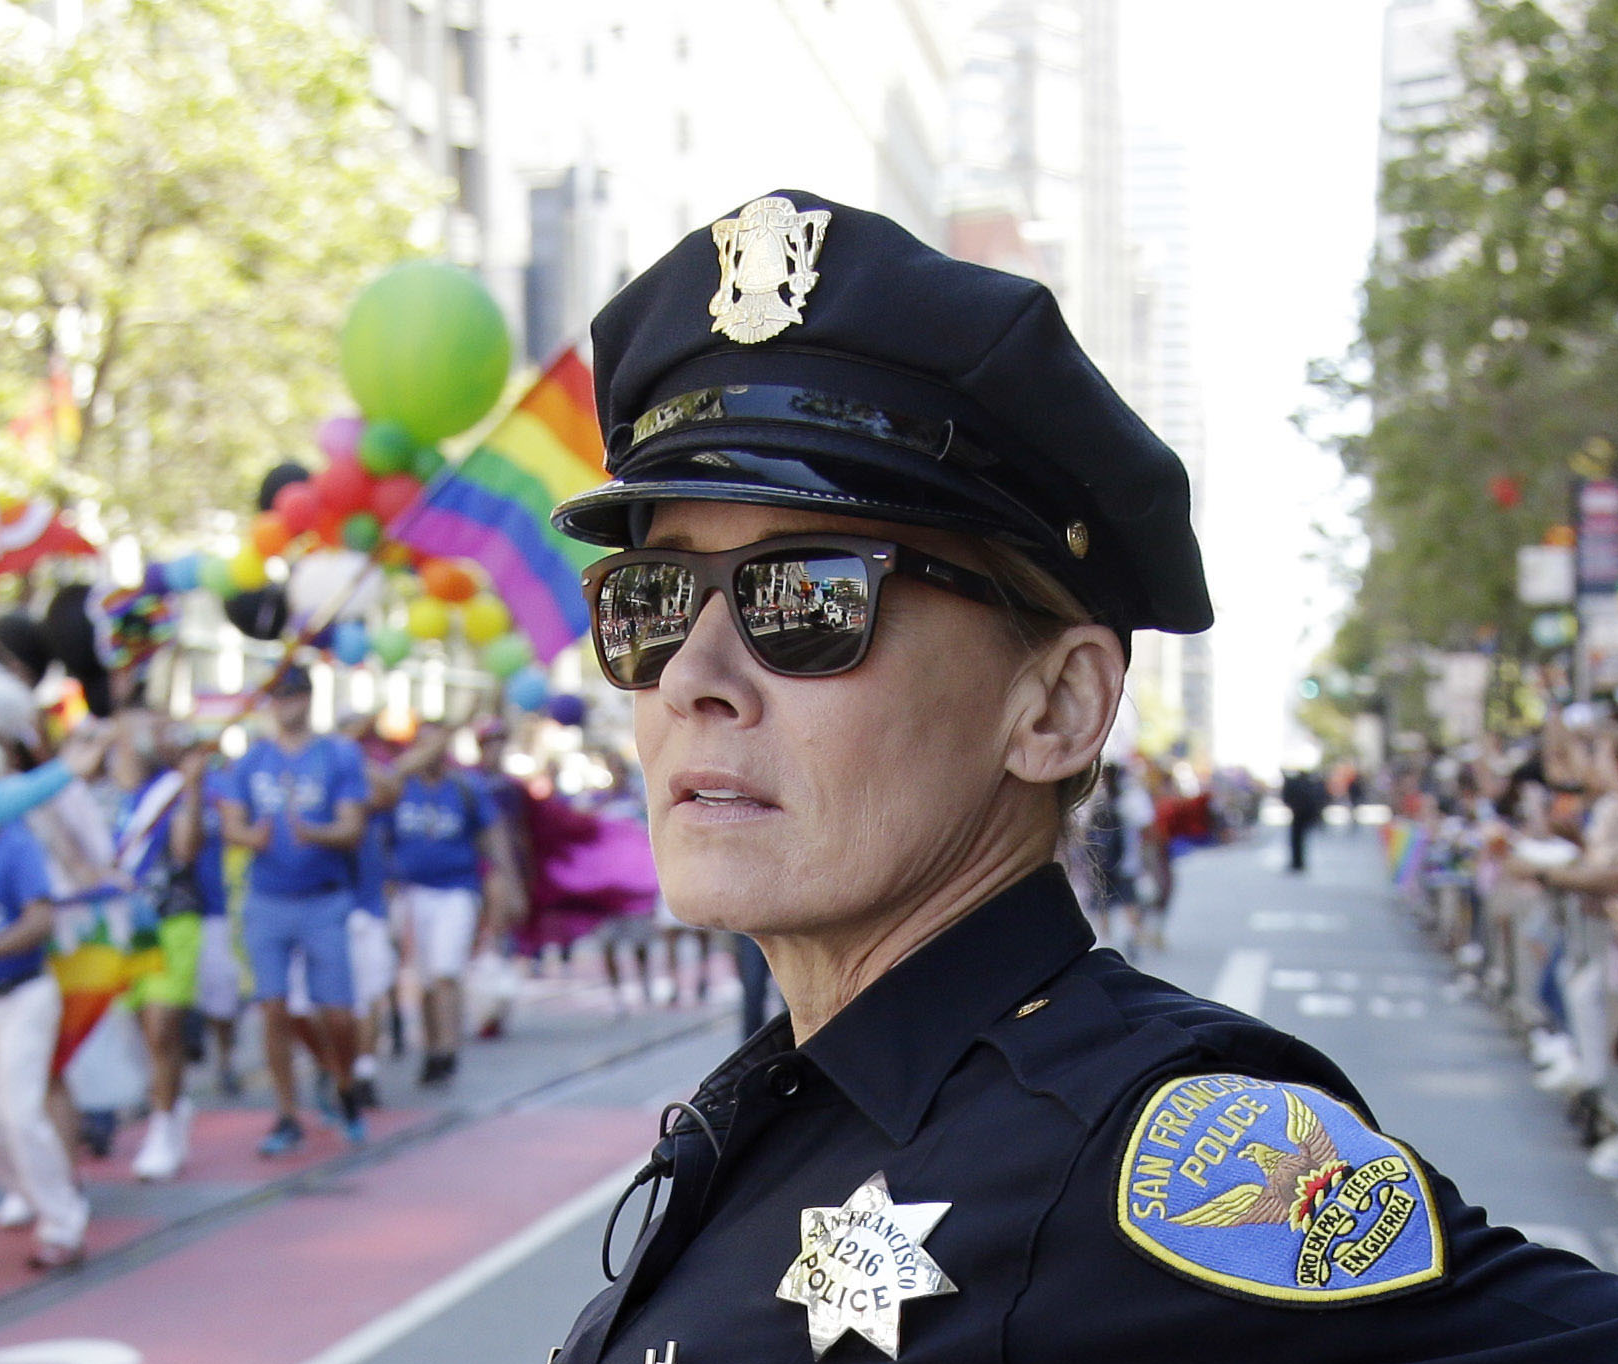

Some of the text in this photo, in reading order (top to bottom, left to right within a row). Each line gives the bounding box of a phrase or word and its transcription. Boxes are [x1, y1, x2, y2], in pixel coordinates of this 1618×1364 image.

[1133, 1075, 1277, 1220] SAN FRANCISCO
[1179, 1094, 1269, 1188] POLICE
[1343, 1160, 1396, 1202] FIERRO
[808, 1210, 917, 1290] SAN FRANCISCO
[828, 1237, 884, 1278] 1216
[1300, 1204, 1347, 1284] ORO EN PAZ
[1341, 1194, 1412, 1273] EN GUERRA
[800, 1251, 892, 1312] POLICE
